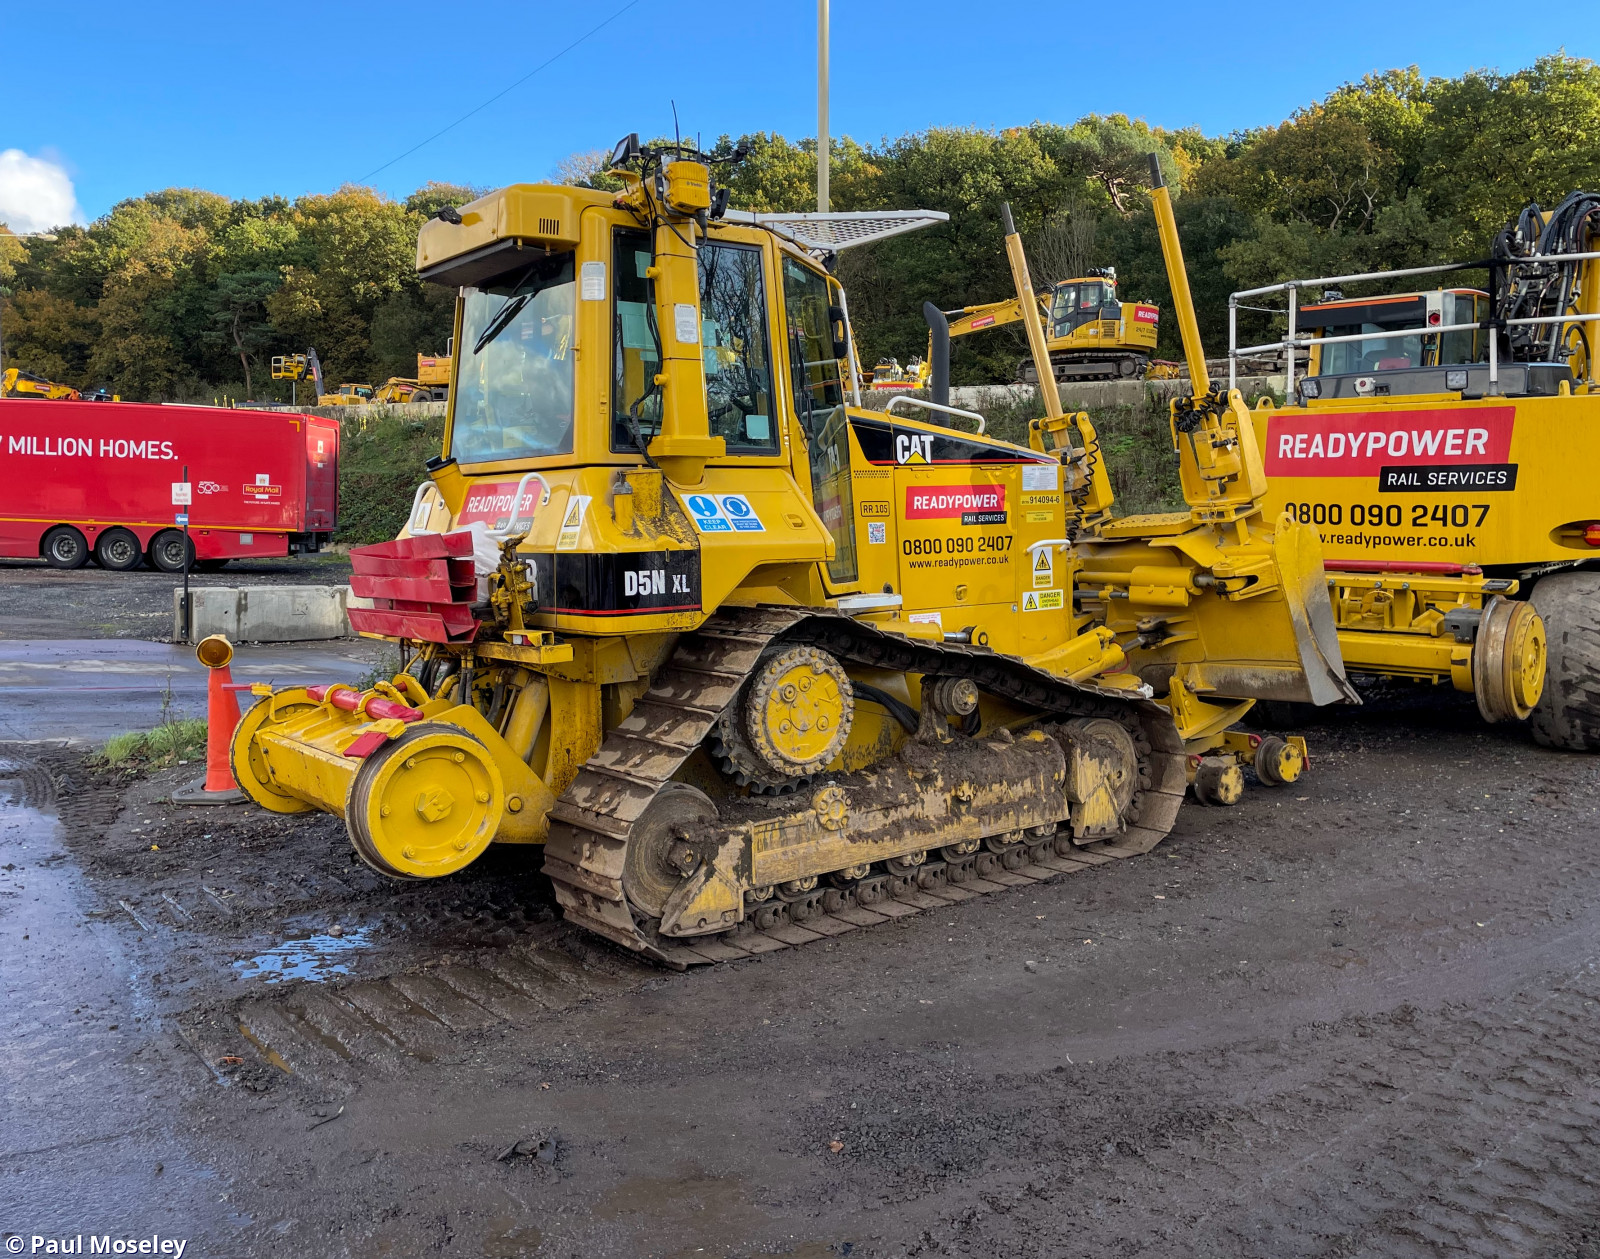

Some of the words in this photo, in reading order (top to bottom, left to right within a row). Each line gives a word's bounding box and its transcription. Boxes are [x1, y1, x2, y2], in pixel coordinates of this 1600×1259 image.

[8, 436, 93, 457] MILLION
[100, 438, 179, 460] HOMES.
[896, 434, 934, 464] CAT
[1278, 428, 1489, 459] READYPOWER
[1387, 472, 1422, 486] RAIL
[1427, 471, 1507, 486] SERVICES
[913, 494, 998, 510] READYPOWER
[1029, 495, 1060, 504] 914094-6
[863, 504, 874, 514] RR
[875, 504, 888, 514] 105
[1285, 502, 1343, 526] 0800
[1350, 504, 1402, 526] 090
[1411, 504, 1491, 528] 2407
[964, 515, 976, 523] RAIL
[978, 514, 1005, 522] SERVICES
[902, 538, 942, 556] 0800
[946, 537, 974, 553] 090
[978, 535, 1013, 552] 2407
[1320, 532, 1476, 549] w.readypower.co.uk
[909, 554, 1009, 569] www.readypower.co.uk
[624, 569, 666, 597] D5N
[672, 574, 691, 593] XL
[1040, 591, 1061, 599] DANGER
